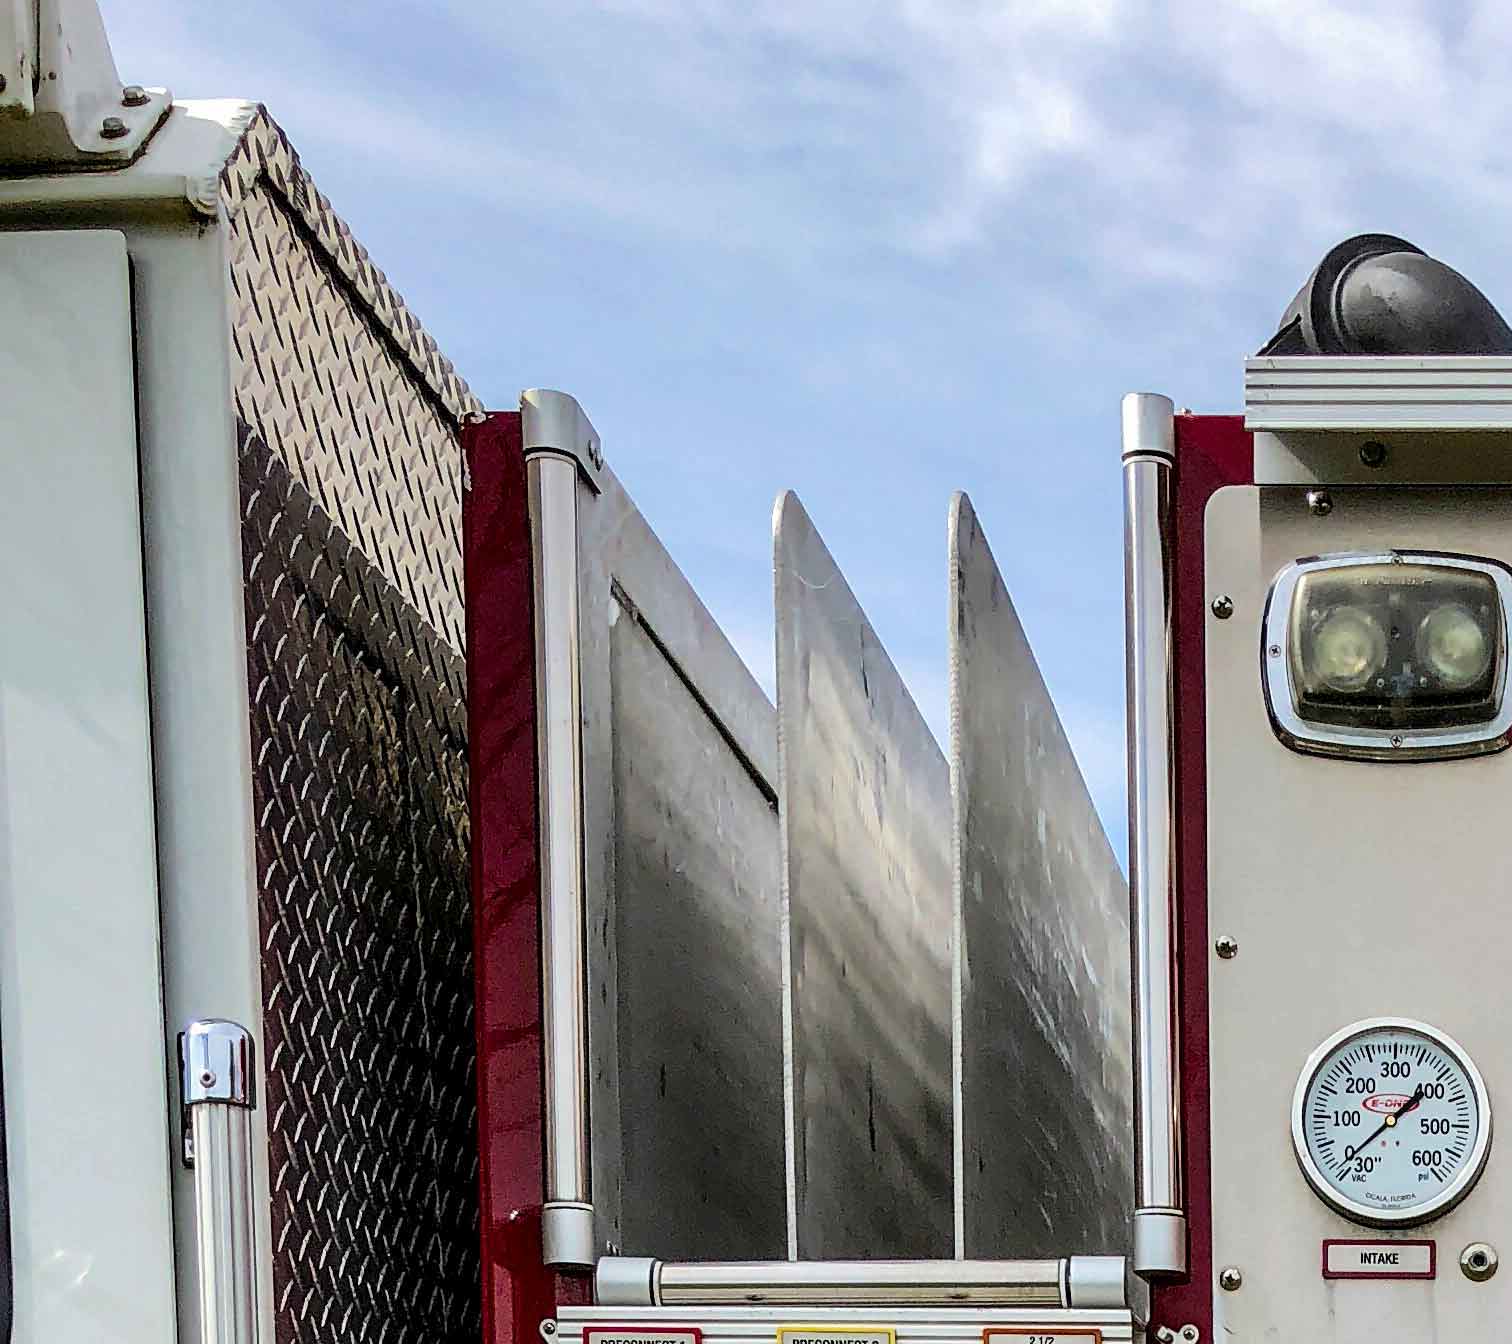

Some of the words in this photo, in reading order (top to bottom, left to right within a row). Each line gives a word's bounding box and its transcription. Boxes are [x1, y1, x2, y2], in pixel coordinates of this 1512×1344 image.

[1380, 1062, 1411, 1078] 300
[1345, 1077, 1376, 1094] 200
[1333, 1111, 1361, 1127] 100
[1420, 1118, 1450, 1135] 500
[1412, 1149, 1442, 1166] 600
[1360, 1252, 1400, 1266] INTAKE
